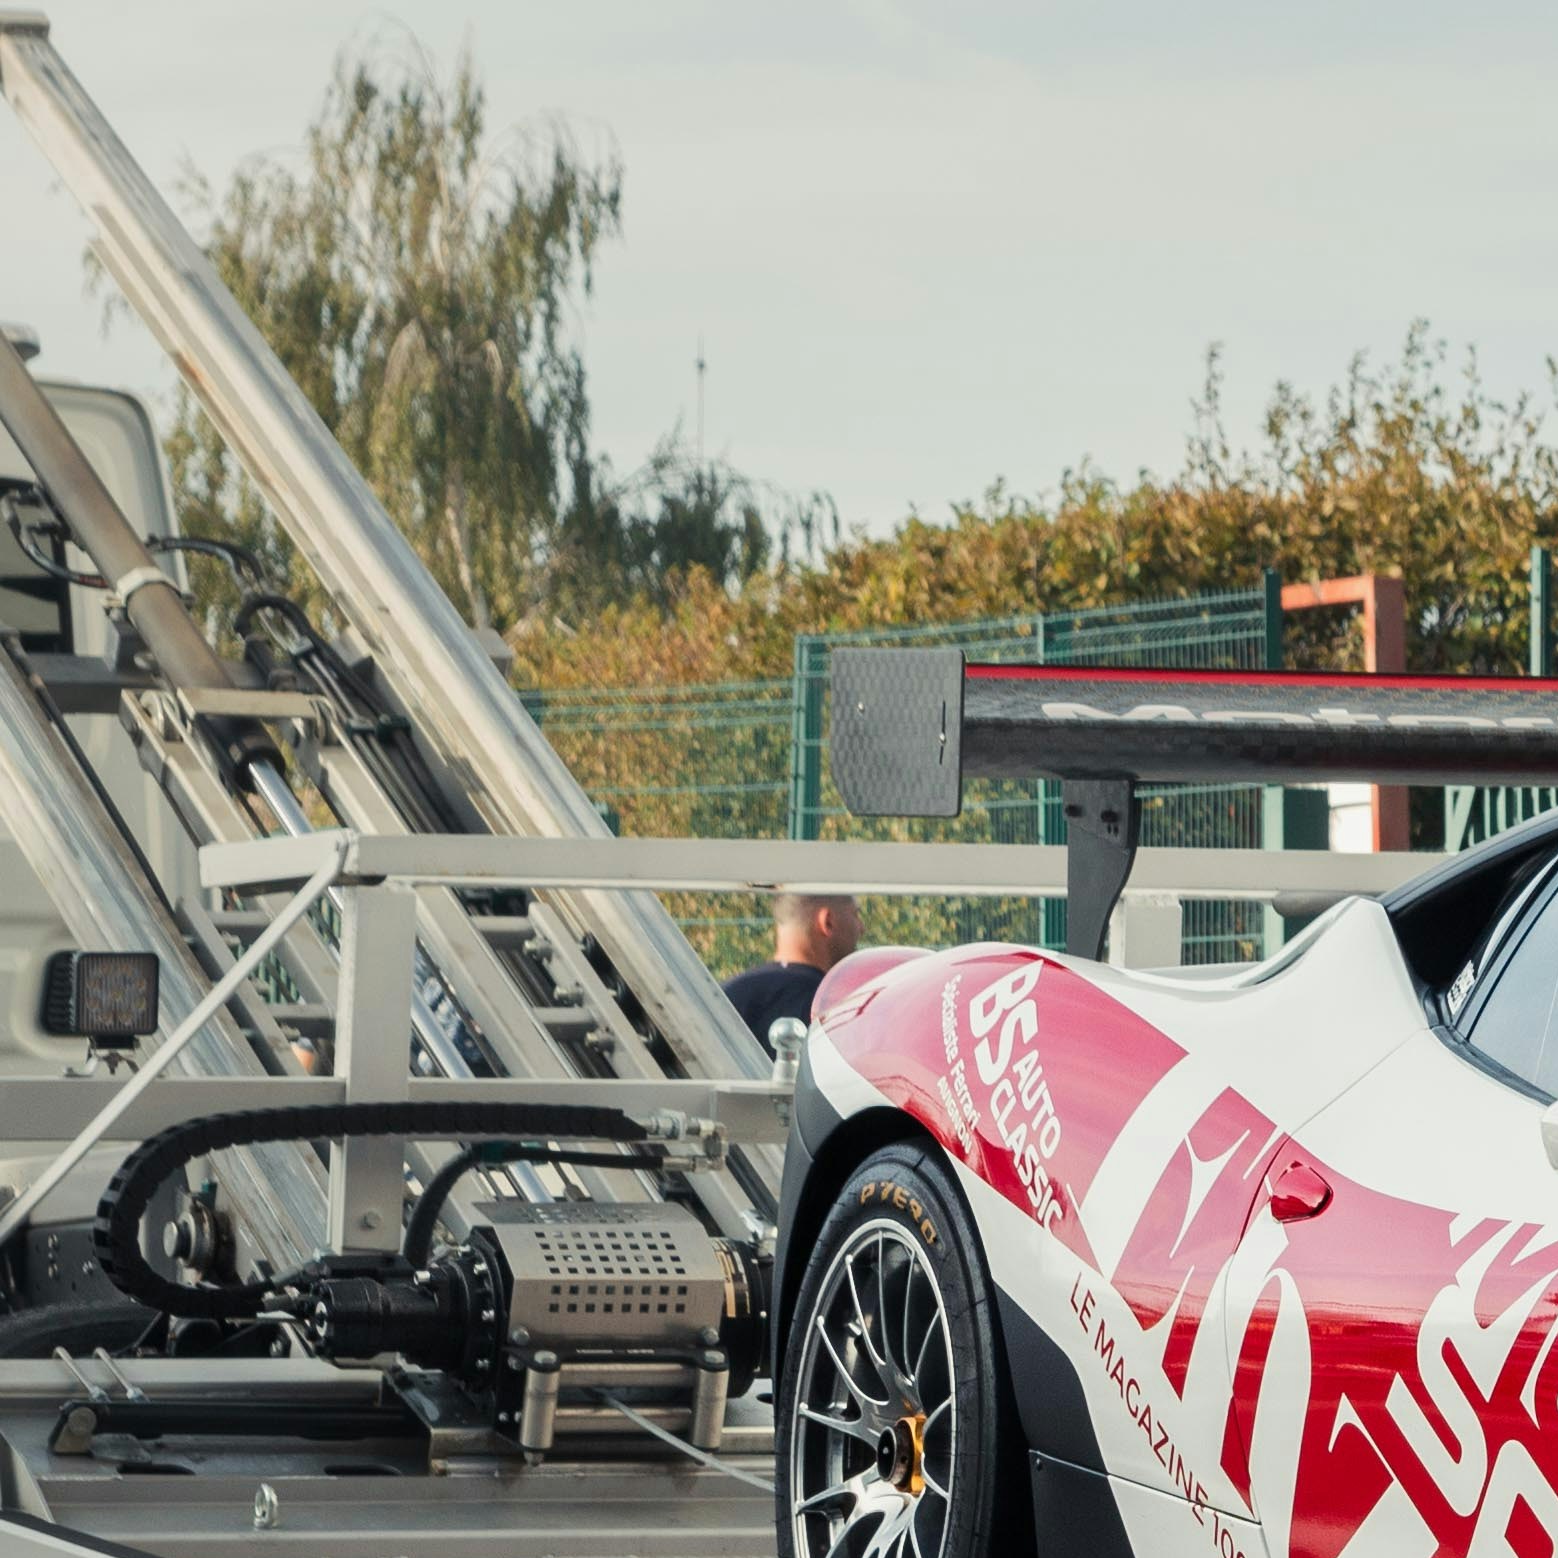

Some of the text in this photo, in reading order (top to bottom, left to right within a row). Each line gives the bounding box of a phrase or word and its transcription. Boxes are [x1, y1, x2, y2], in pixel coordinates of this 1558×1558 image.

[969, 960, 1044, 1087] BS
[936, 1076, 971, 1155] AVIGNON
[950, 1051, 981, 1130] Ferrari
[1012, 1049, 1062, 1159] AUTO
[1070, 1272, 1096, 1333] LE
[1094, 1318, 1209, 1527] MAGAZINE
